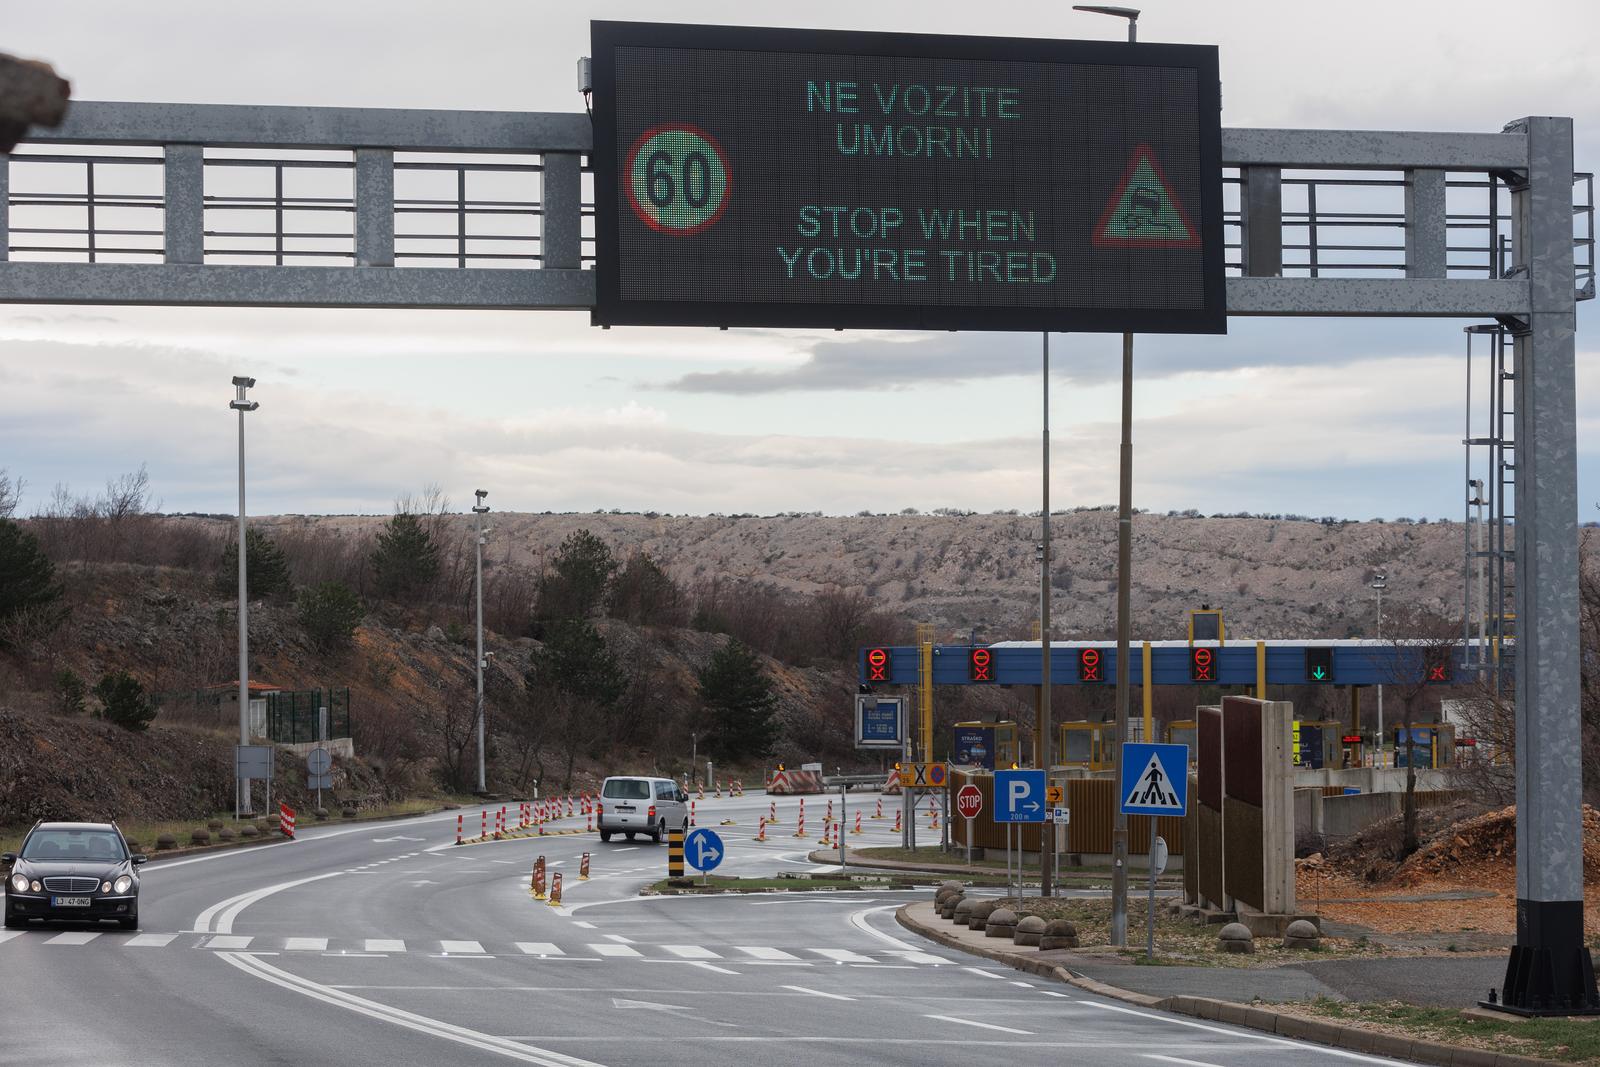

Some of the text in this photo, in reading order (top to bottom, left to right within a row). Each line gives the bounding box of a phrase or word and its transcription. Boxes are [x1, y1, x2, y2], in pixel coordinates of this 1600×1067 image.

[807, 80, 1024, 118] NE VOZITE
[836, 123, 992, 158] UMORNI
[646, 149, 711, 208] 60
[798, 205, 1036, 241] STOP WHEN
[776, 247, 1057, 282] YOU'RE TIRED
[960, 795, 980, 809] STOP
[1009, 780, 1031, 812] P
